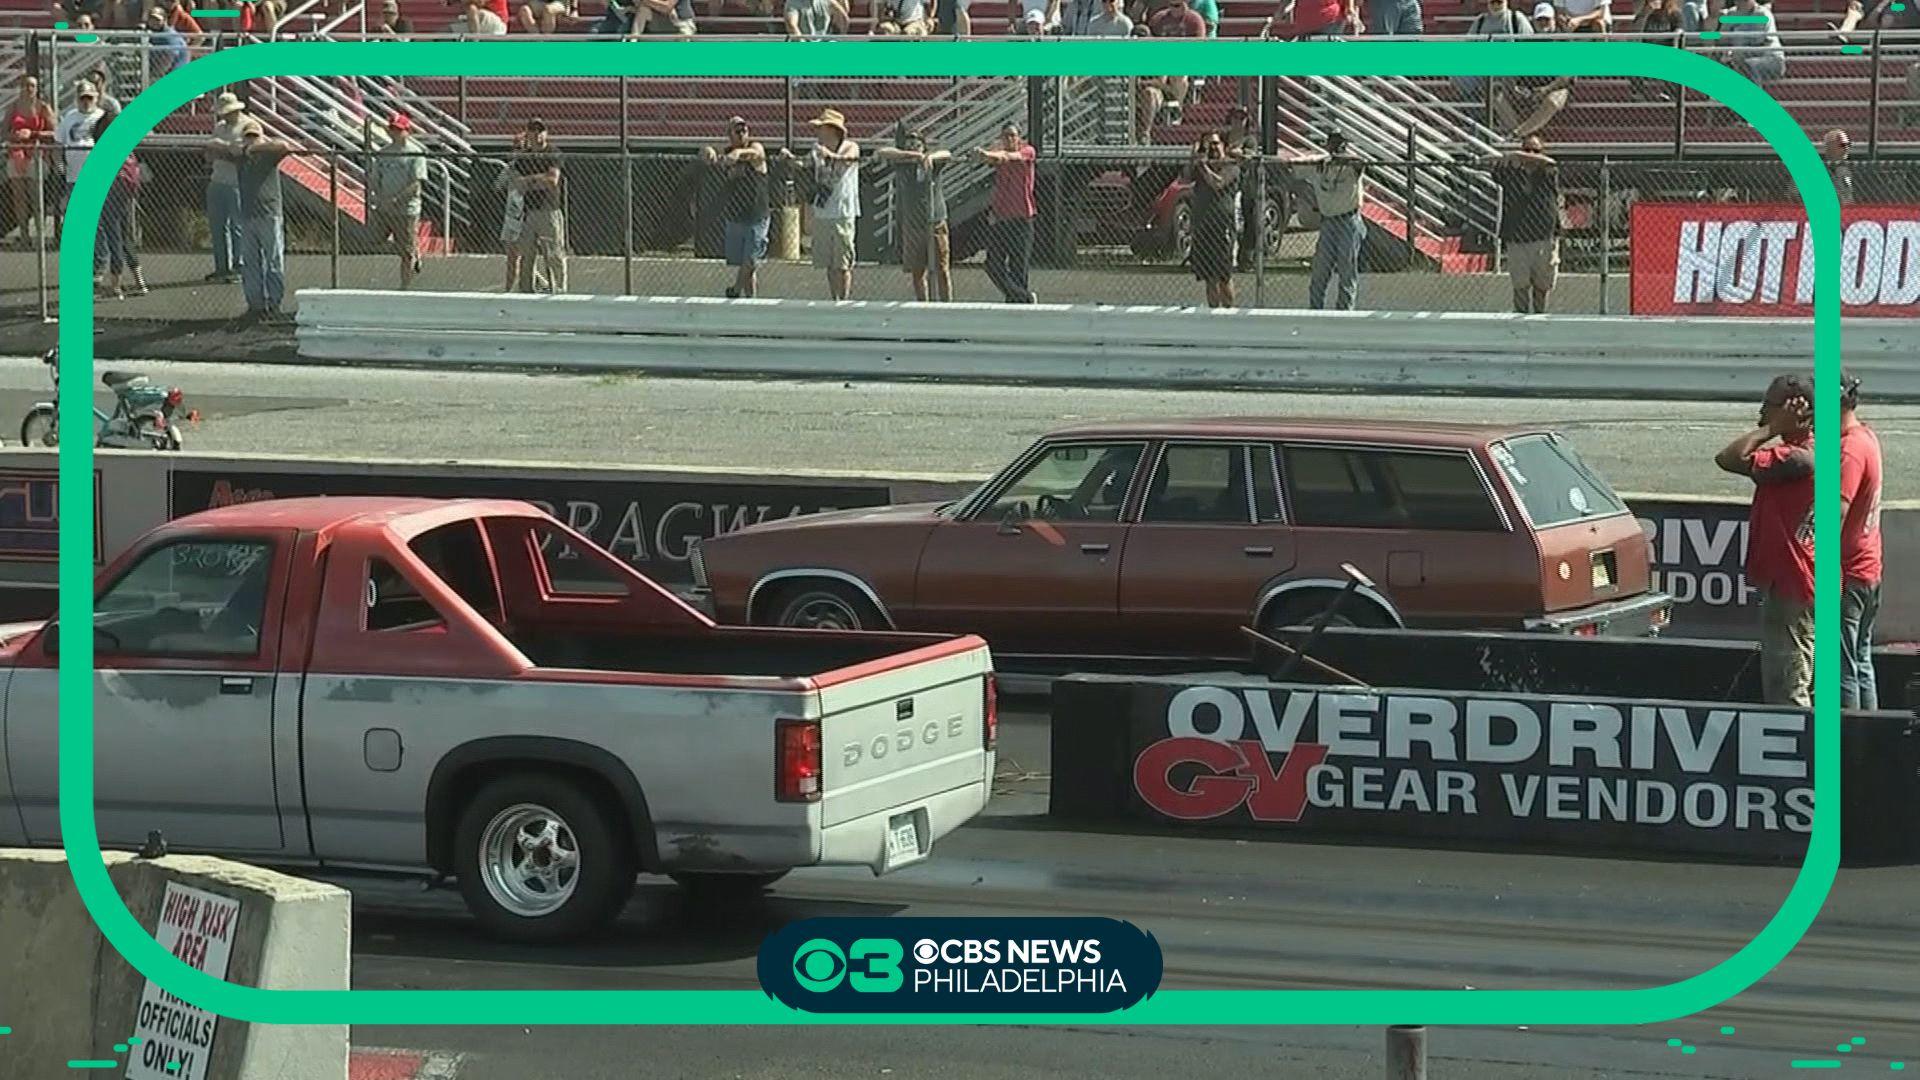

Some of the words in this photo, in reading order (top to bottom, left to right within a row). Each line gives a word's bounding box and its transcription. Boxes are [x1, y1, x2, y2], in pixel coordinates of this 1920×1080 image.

[1674, 220, 1798, 304] HOT
[843, 713, 963, 767] DODGE
[1167, 686, 1807, 778] OVERDRIVE
[1306, 763, 1477, 813] GEAR
[1504, 774, 1815, 833] VENDORS
[163, 891, 201, 931] HIGH
[198, 900, 237, 943] RISK
[172, 931, 209, 972] AREA
[140, 1001, 212, 1048] OFFICIALS
[142, 1039, 195, 1080] ONLY!
